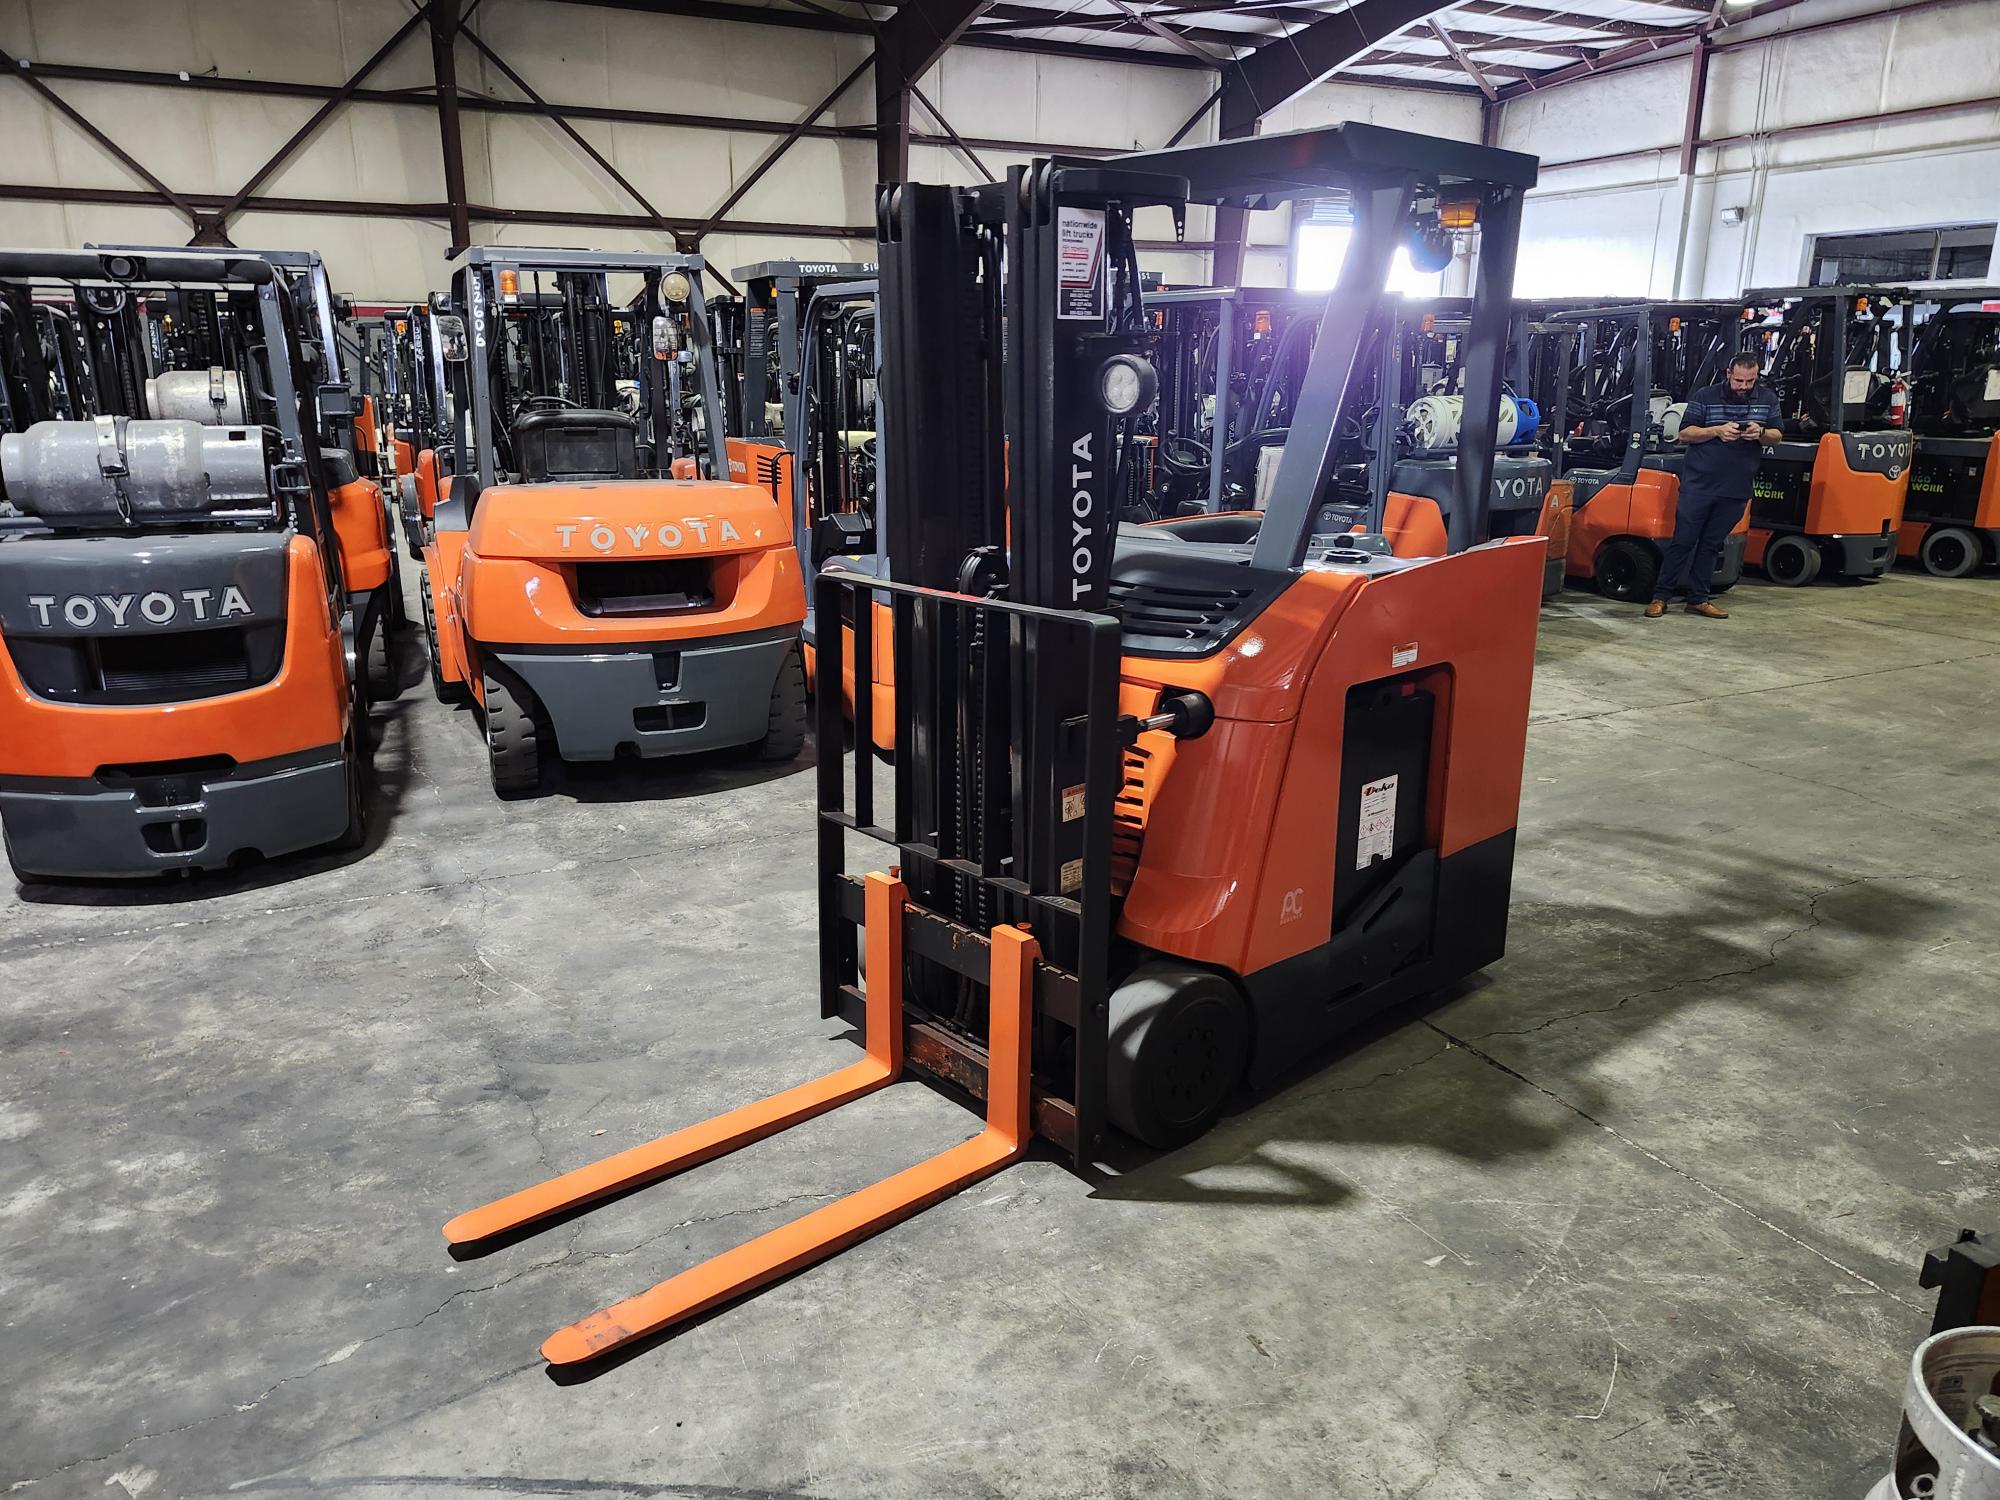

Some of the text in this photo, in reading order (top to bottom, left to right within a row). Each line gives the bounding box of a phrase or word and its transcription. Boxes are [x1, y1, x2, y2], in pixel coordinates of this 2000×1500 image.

[1062, 220, 1097, 229] nationwide
[1062, 229, 1071, 237] lift
[799, 264, 838, 273] TOYOTA
[1577, 477, 1599, 485] TOYOTA
[1496, 476, 1543, 499] YOTA
[1912, 483, 1944, 493] WORK
[1754, 489, 1784, 500] WORK
[1072, 432, 1093, 601] TOYOTA
[1331, 513, 1353, 524] TOYOTA
[555, 519, 742, 551] TOYOTA
[28, 586, 254, 628] TOYOTA
